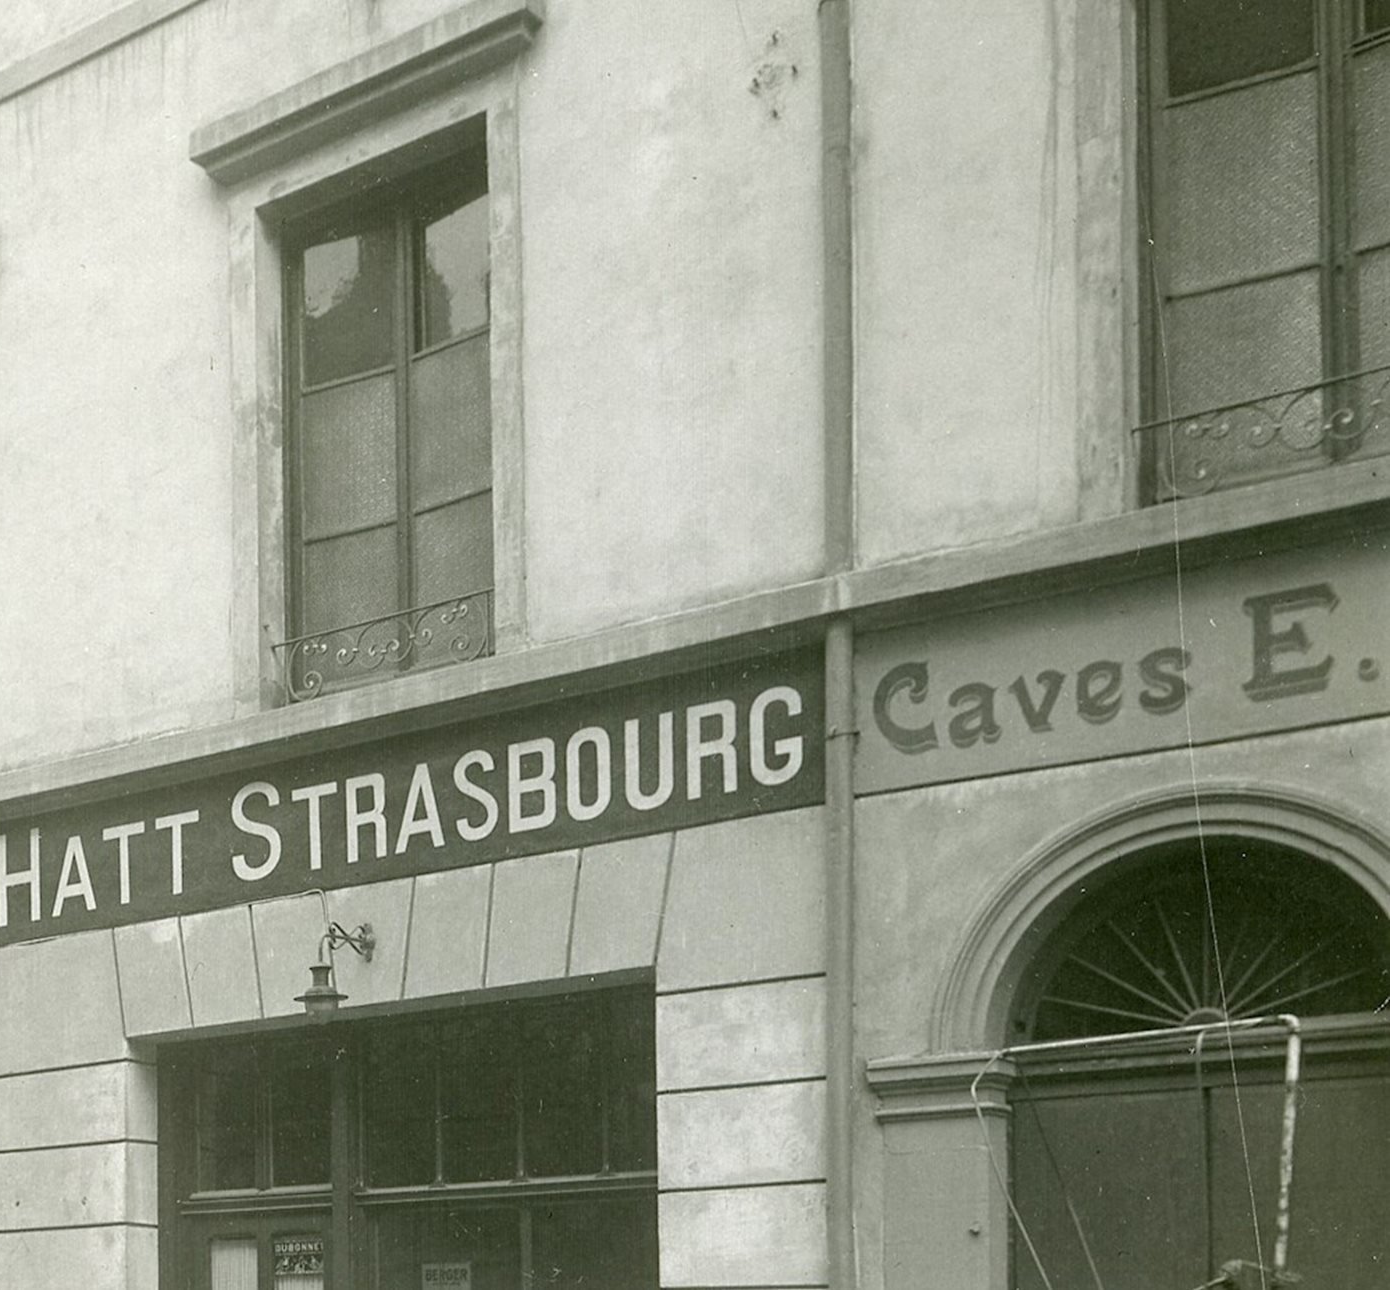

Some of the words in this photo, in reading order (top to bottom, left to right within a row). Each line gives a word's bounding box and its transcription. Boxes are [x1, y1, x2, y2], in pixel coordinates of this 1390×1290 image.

[873, 646, 1193, 755] Caves
[1242, 581, 1380, 701] E.
[232, 685, 805, 882] STRASBOURG
